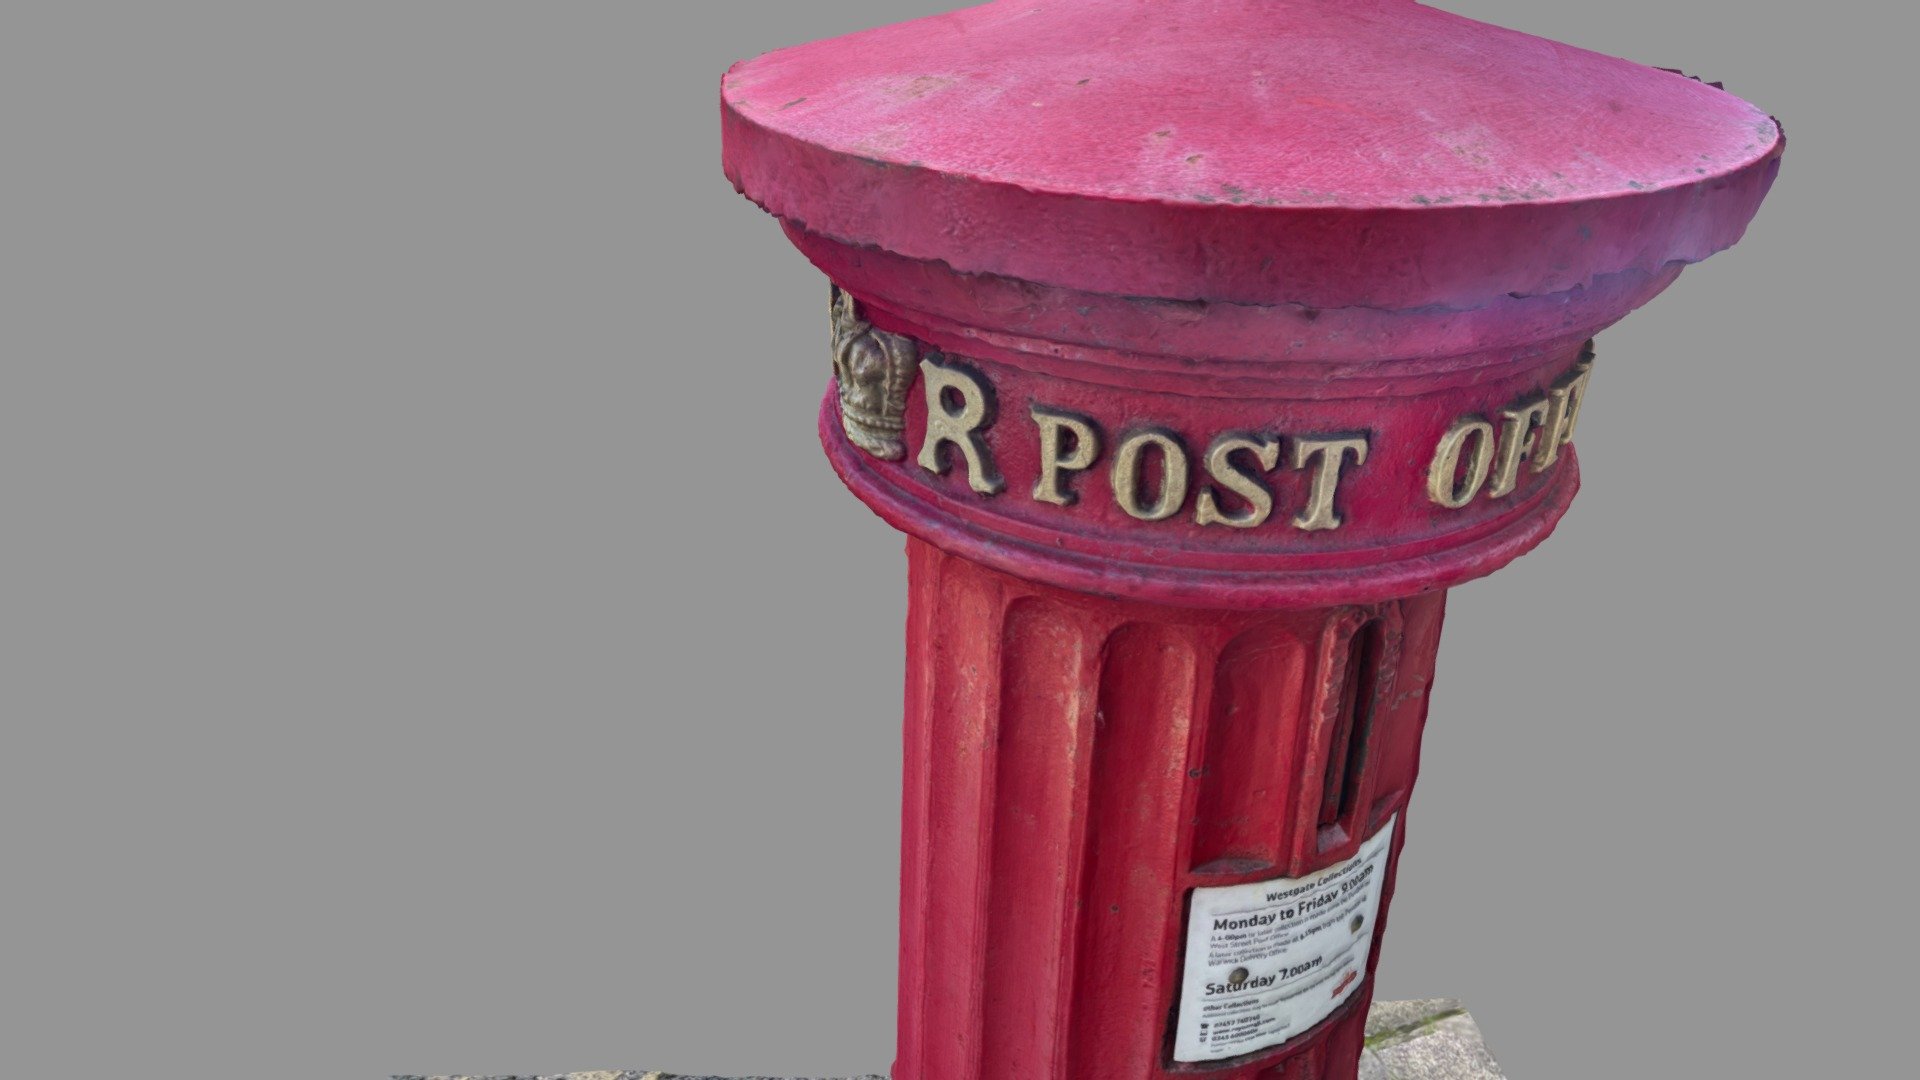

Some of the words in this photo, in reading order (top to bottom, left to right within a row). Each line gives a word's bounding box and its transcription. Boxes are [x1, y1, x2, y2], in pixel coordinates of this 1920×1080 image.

[918, 356, 1003, 496] R
[1031, 408, 1368, 531] POST
[1213, 913, 1277, 931] Monday
[1280, 908, 1295, 921] to
[1298, 890, 1339, 916] Friday
[1266, 883, 1316, 902] Westgate
[1204, 974, 1277, 996] Saturday
[1278, 955, 1323, 980] 7.00am
